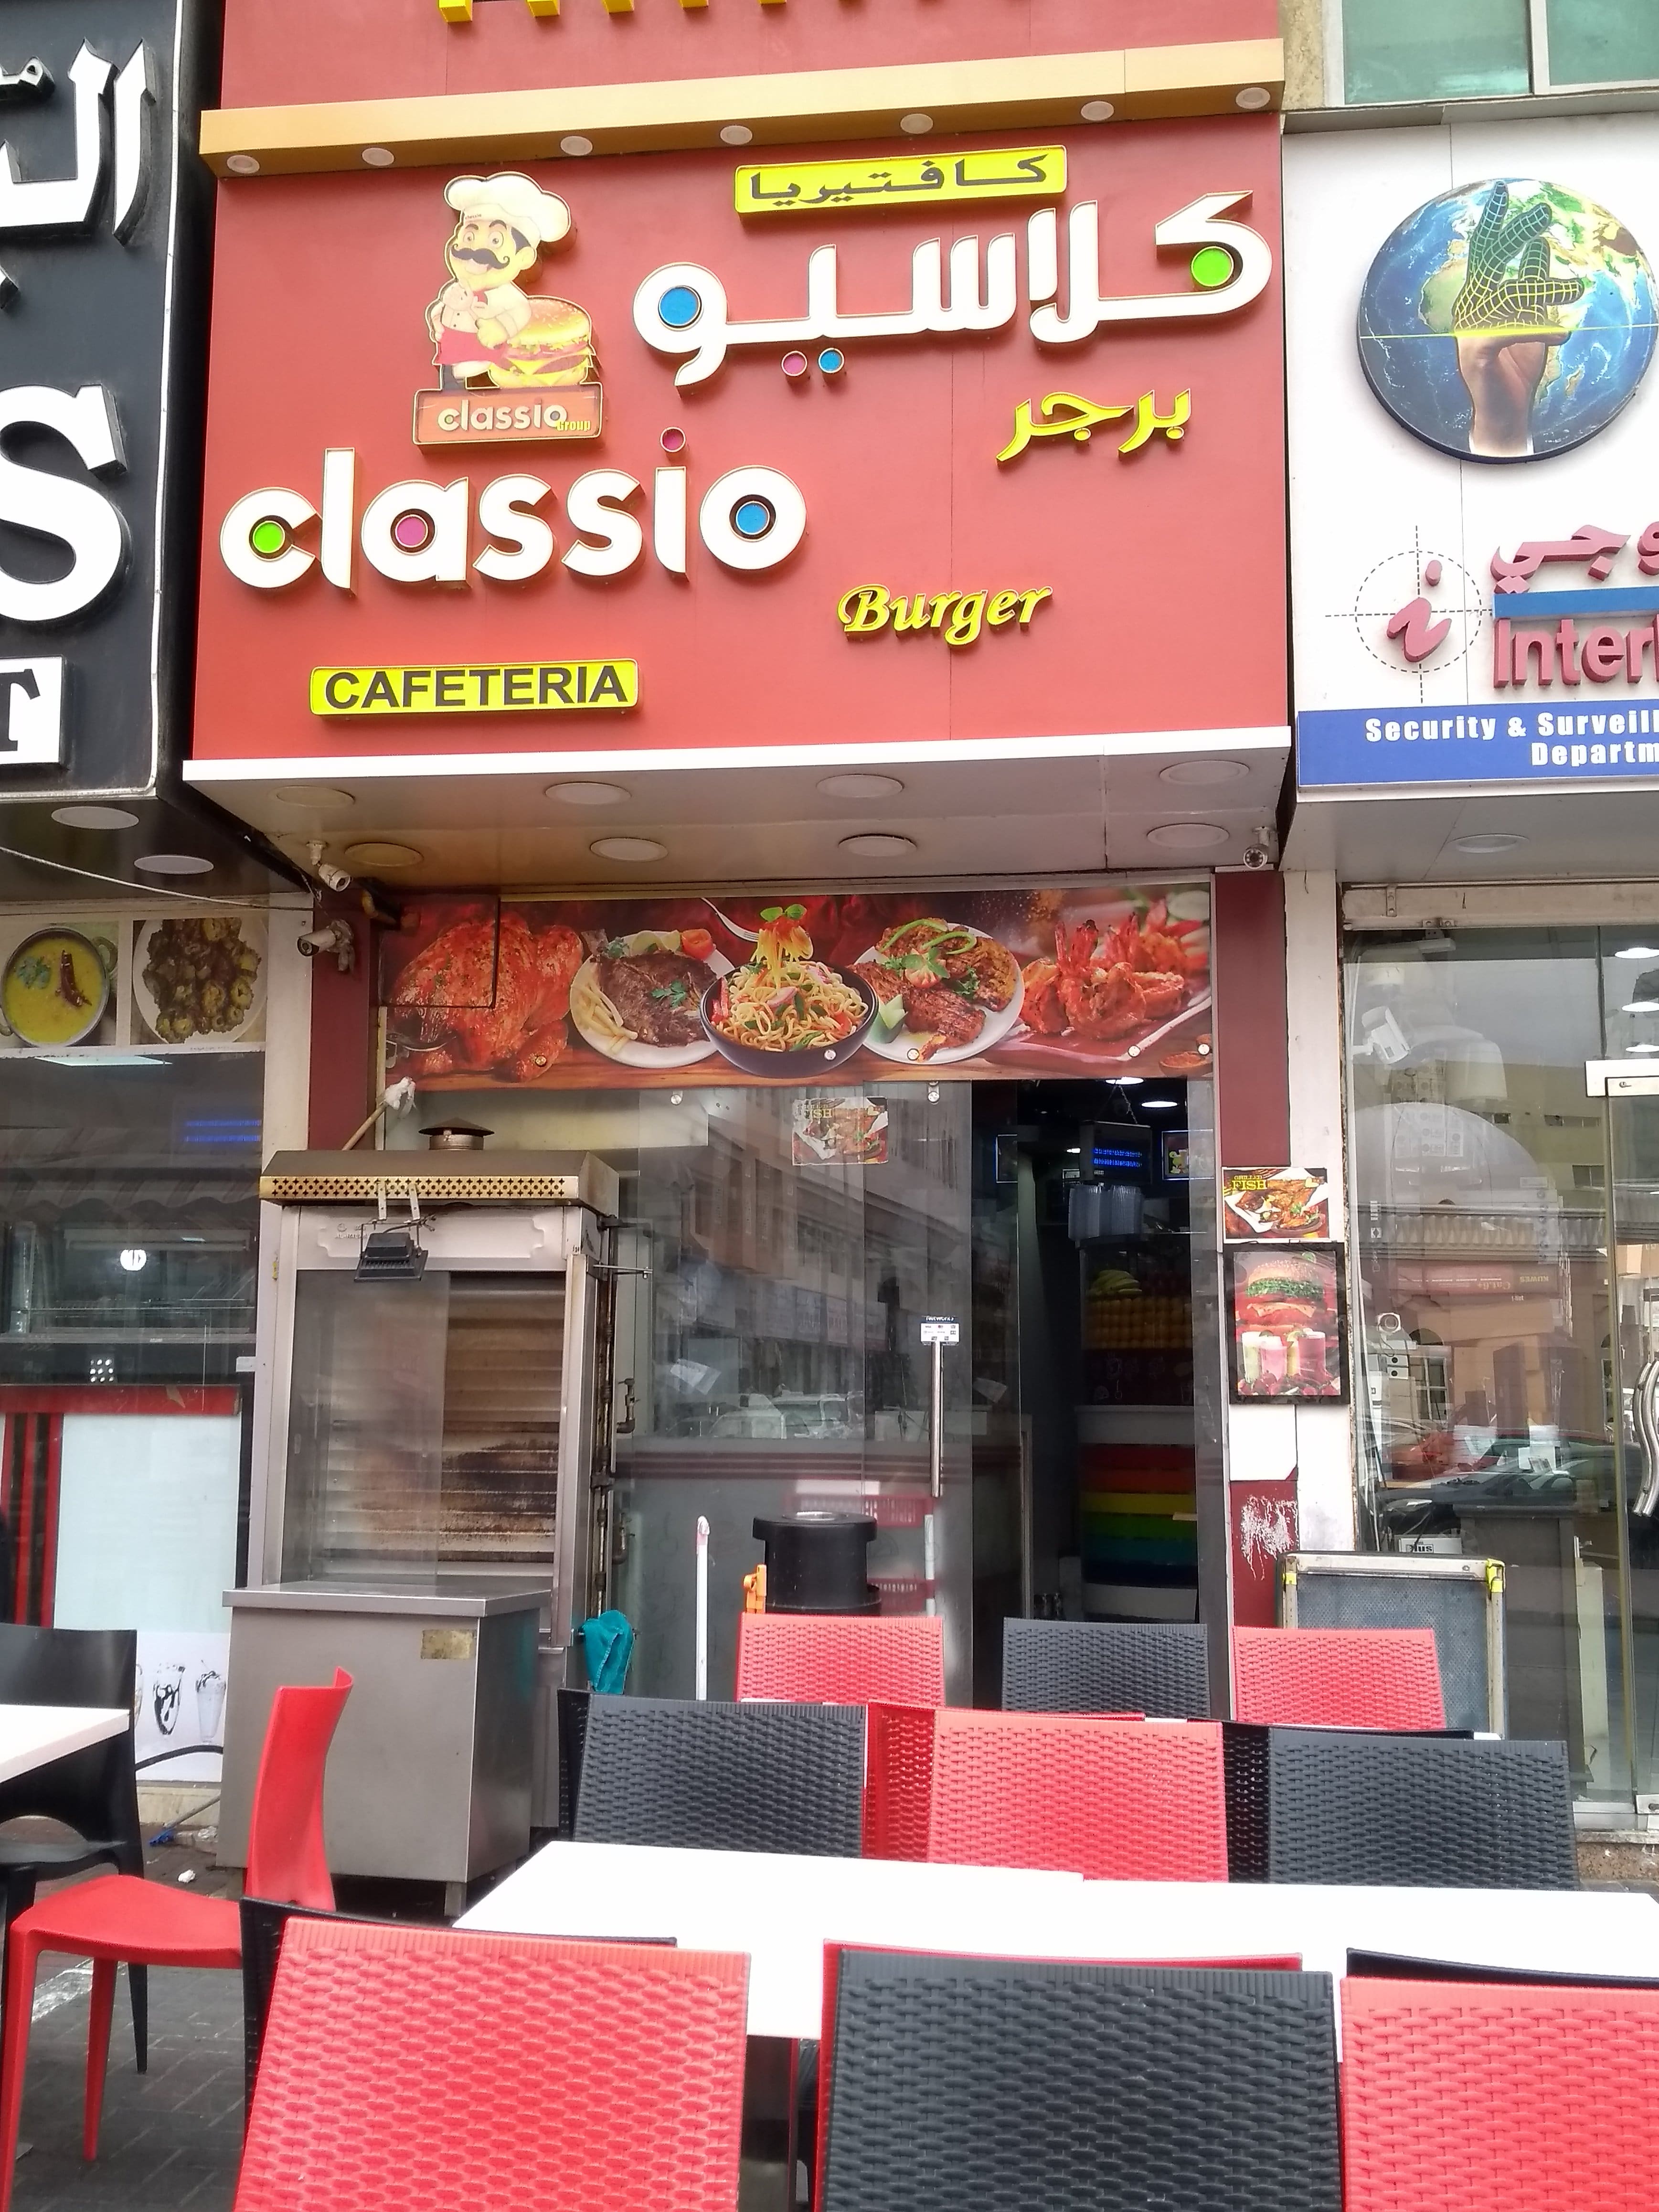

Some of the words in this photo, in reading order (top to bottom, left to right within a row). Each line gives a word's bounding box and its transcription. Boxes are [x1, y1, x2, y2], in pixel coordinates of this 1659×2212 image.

[751, 155, 1048, 206] كافتيريا
[633, 190, 1272, 389] كلاسيو
[437, 397, 567, 431] classio
[556, 420, 591, 432] Group
[997, 388, 1192, 464] برجر
[220, 427, 808, 596] classio
[837, 583, 1053, 647] Burger
[1493, 614, 1659, 689] Inter
[325, 665, 627, 709] CAFETERIA
[1365, 716, 1496, 742] Security
[1507, 718, 1527, 738] &
[1232, 1180, 1268, 1191] FISH
